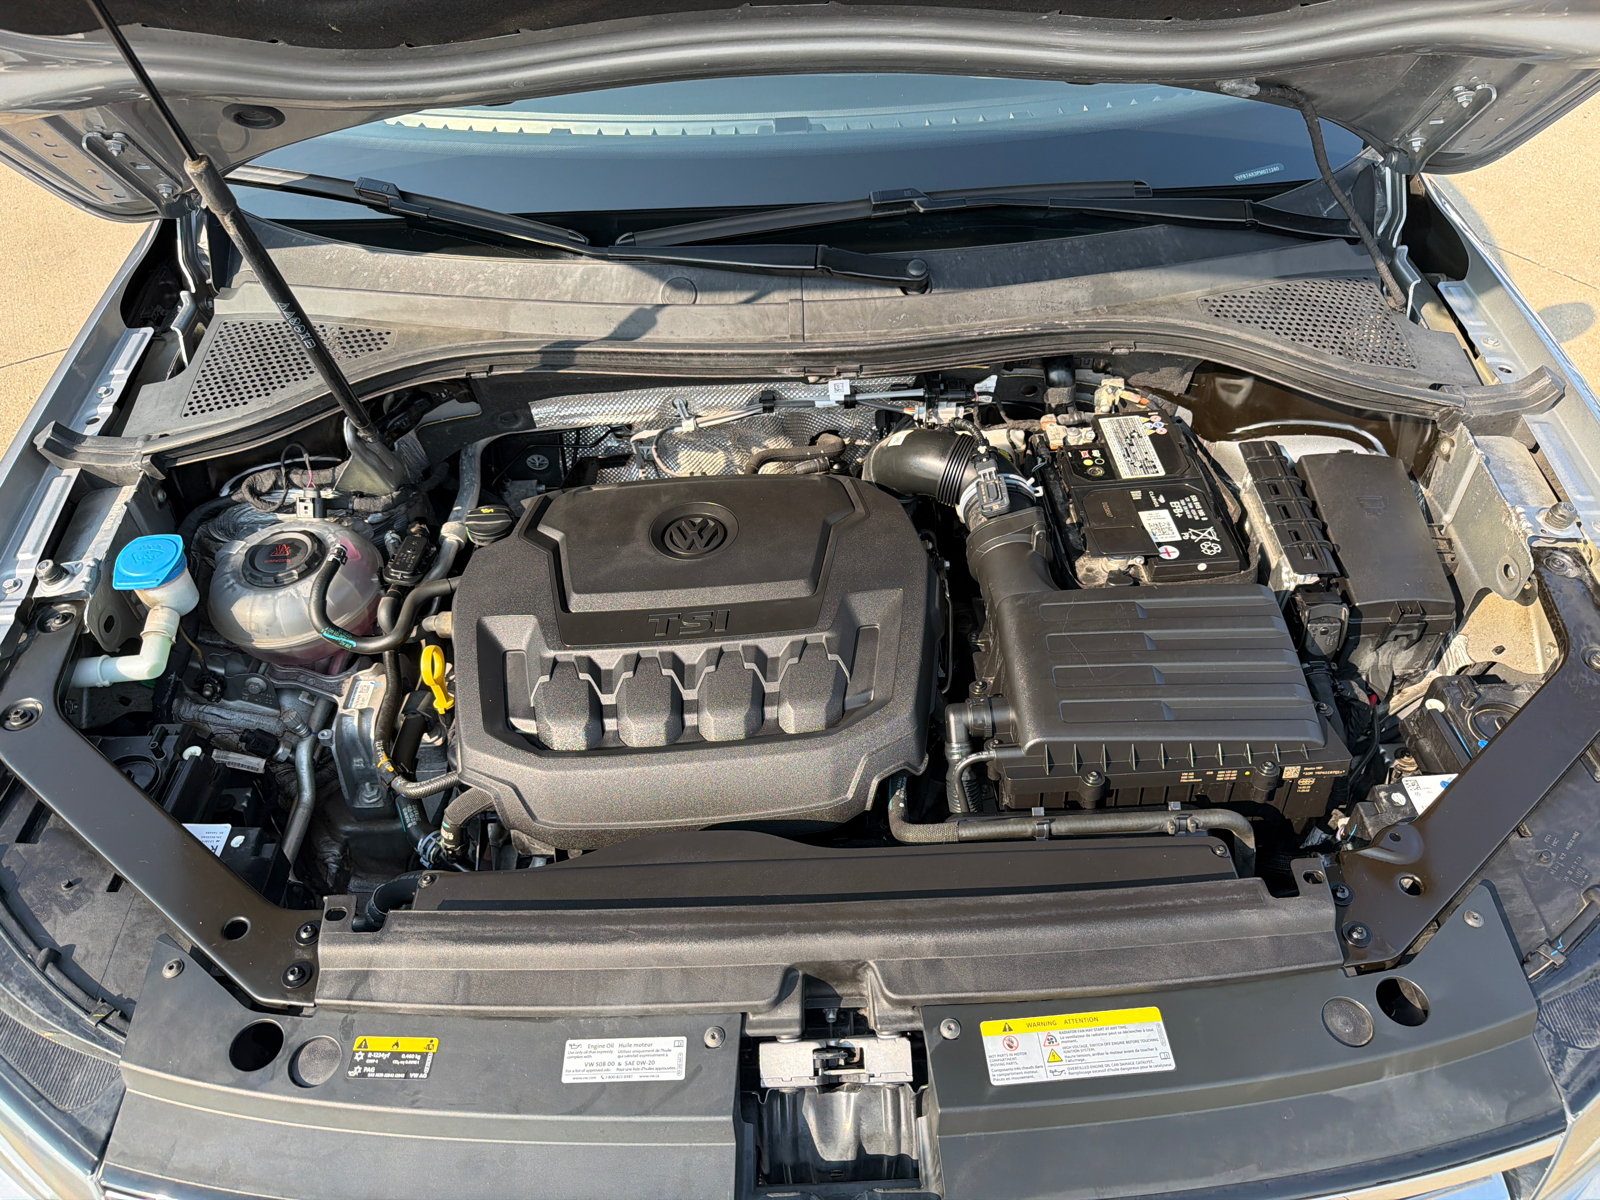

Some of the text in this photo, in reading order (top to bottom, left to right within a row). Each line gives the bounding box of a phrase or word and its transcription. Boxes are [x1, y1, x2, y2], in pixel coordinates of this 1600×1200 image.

[1170, 501, 1183, 518] EFB+
[665, 515, 723, 554] VW
[648, 609, 730, 636] TSI
[1064, 1017, 1099, 1025] ATTENTION
